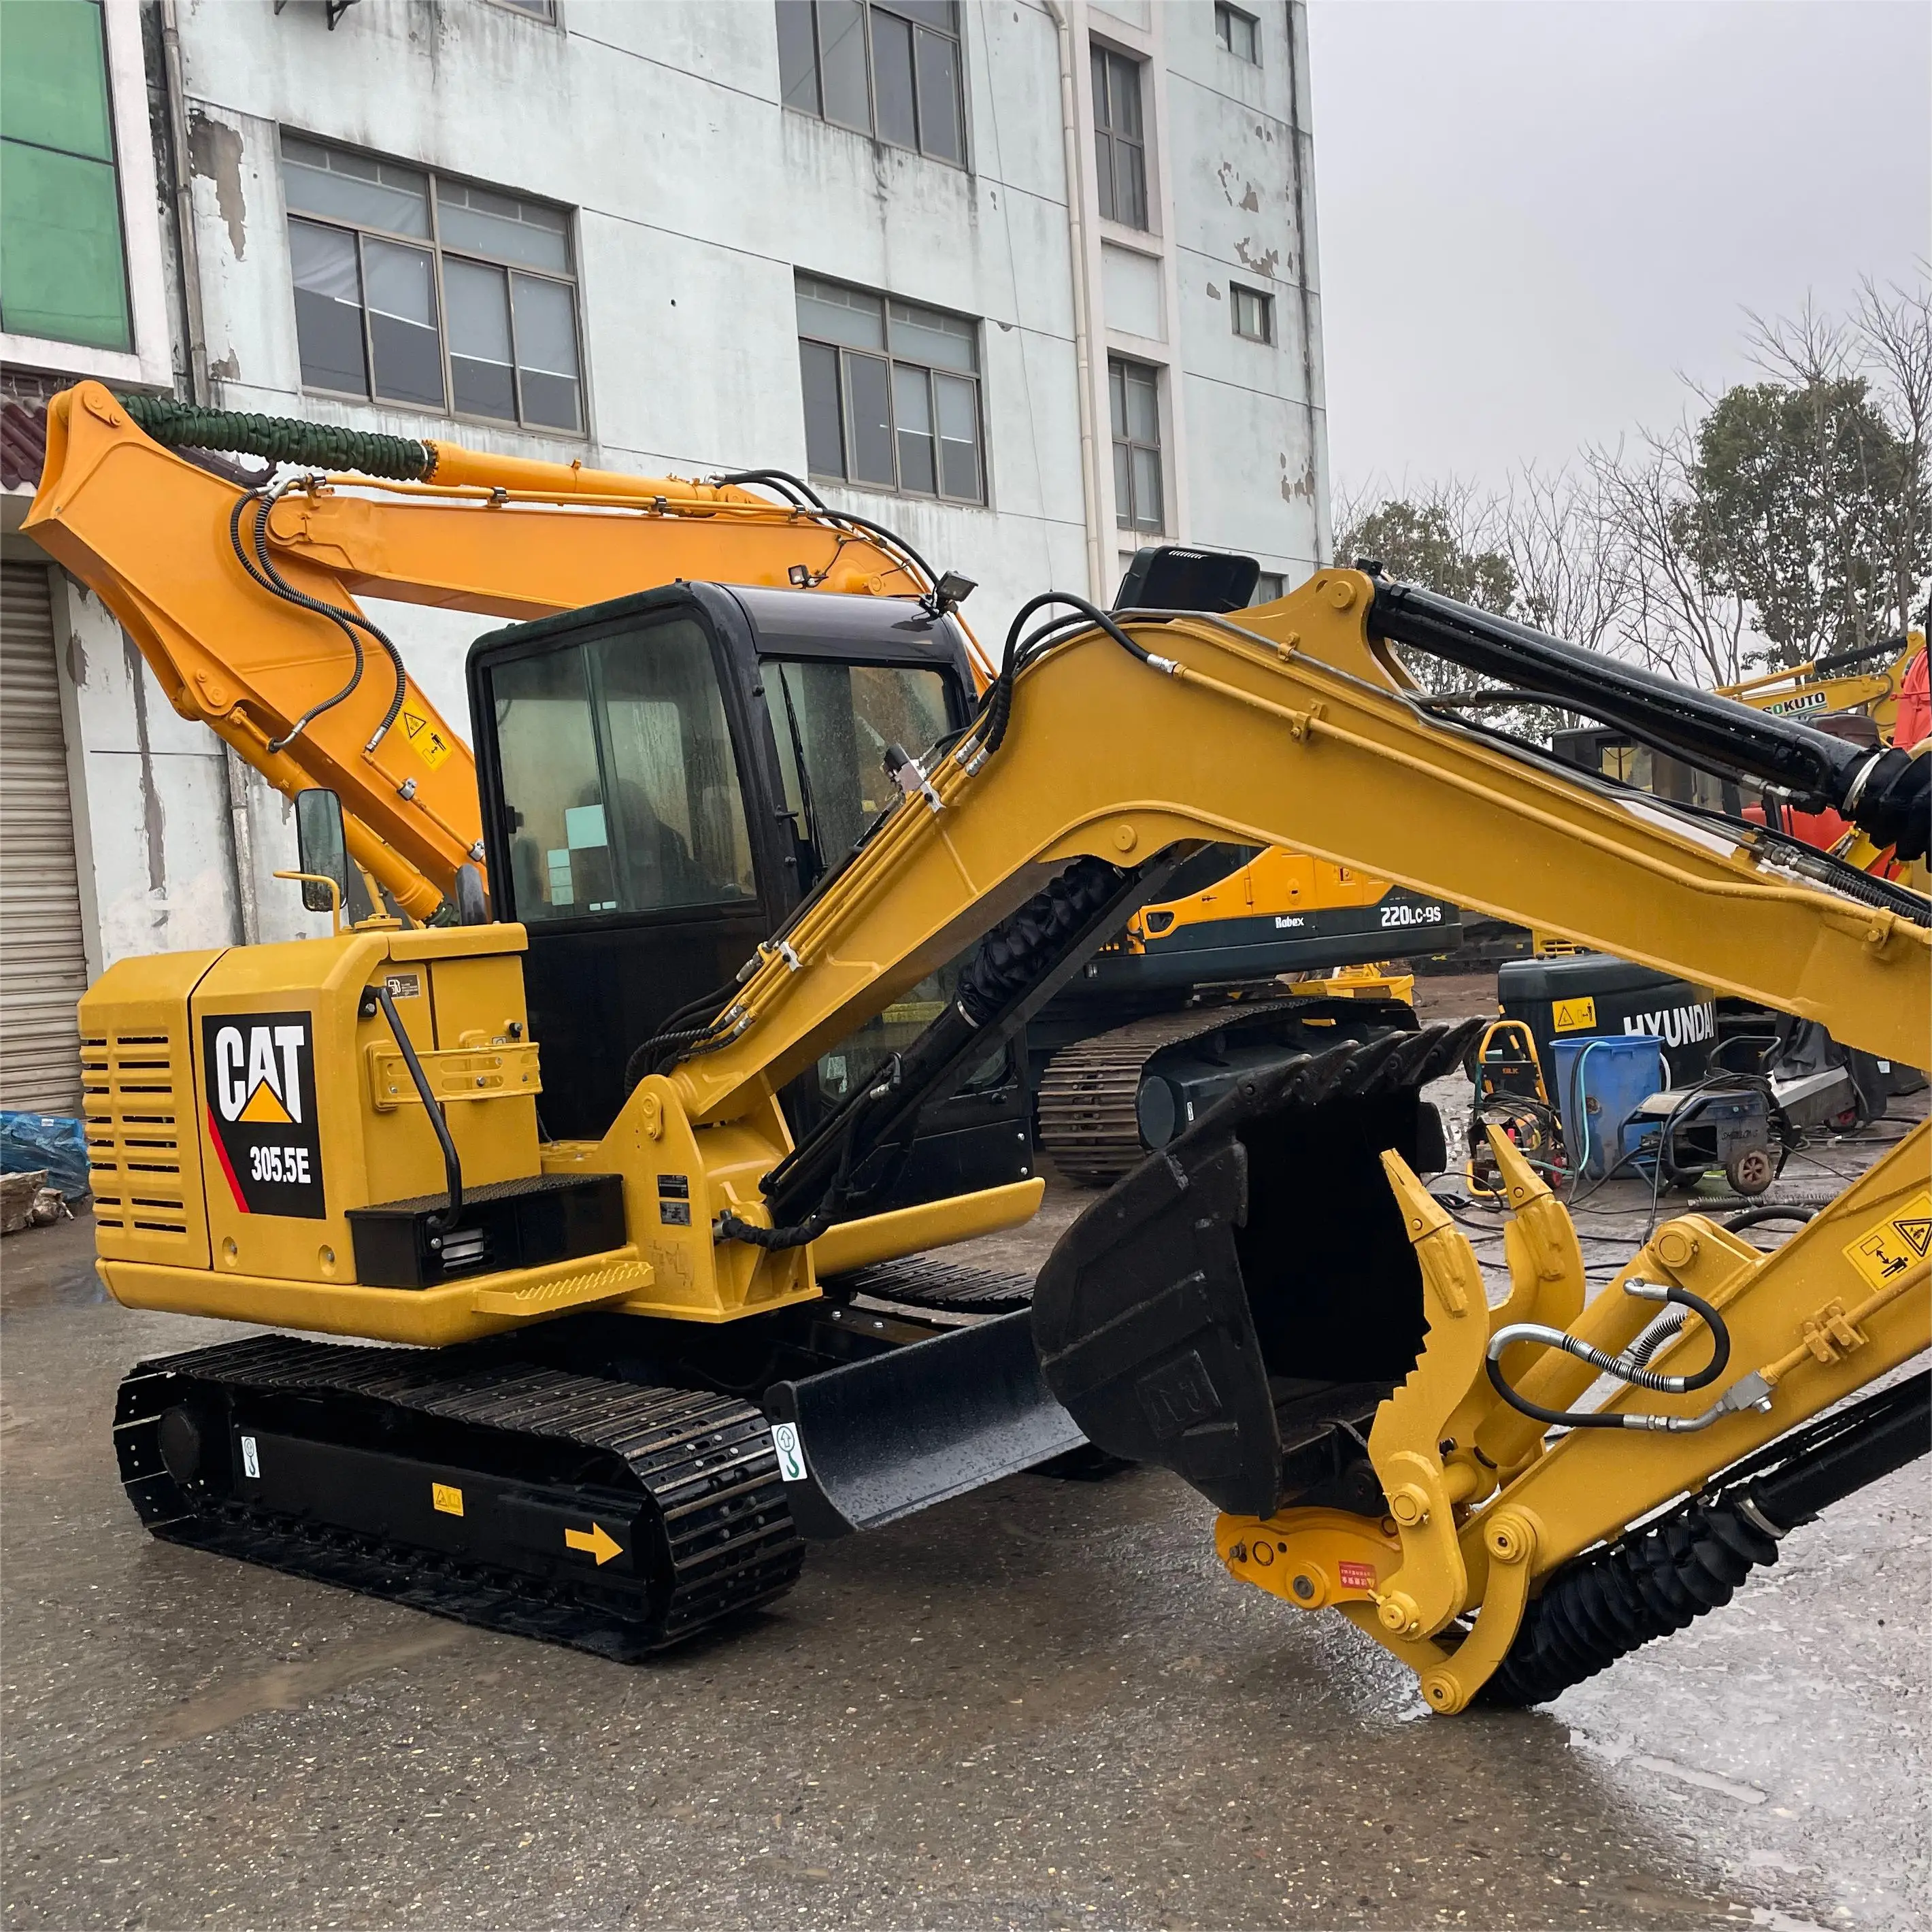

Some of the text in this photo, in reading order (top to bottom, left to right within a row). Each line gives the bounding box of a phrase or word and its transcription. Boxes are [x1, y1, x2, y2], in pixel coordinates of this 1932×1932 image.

[1762, 692, 1825, 714] SOKUTO
[1275, 916, 1305, 929] Robex
[1380, 905, 1442, 927] 220LC-9S
[1622, 1001, 1715, 1048] HYUNDAI
[215, 1025, 305, 1124] CAT
[249, 1146, 312, 1184] 305.5E
